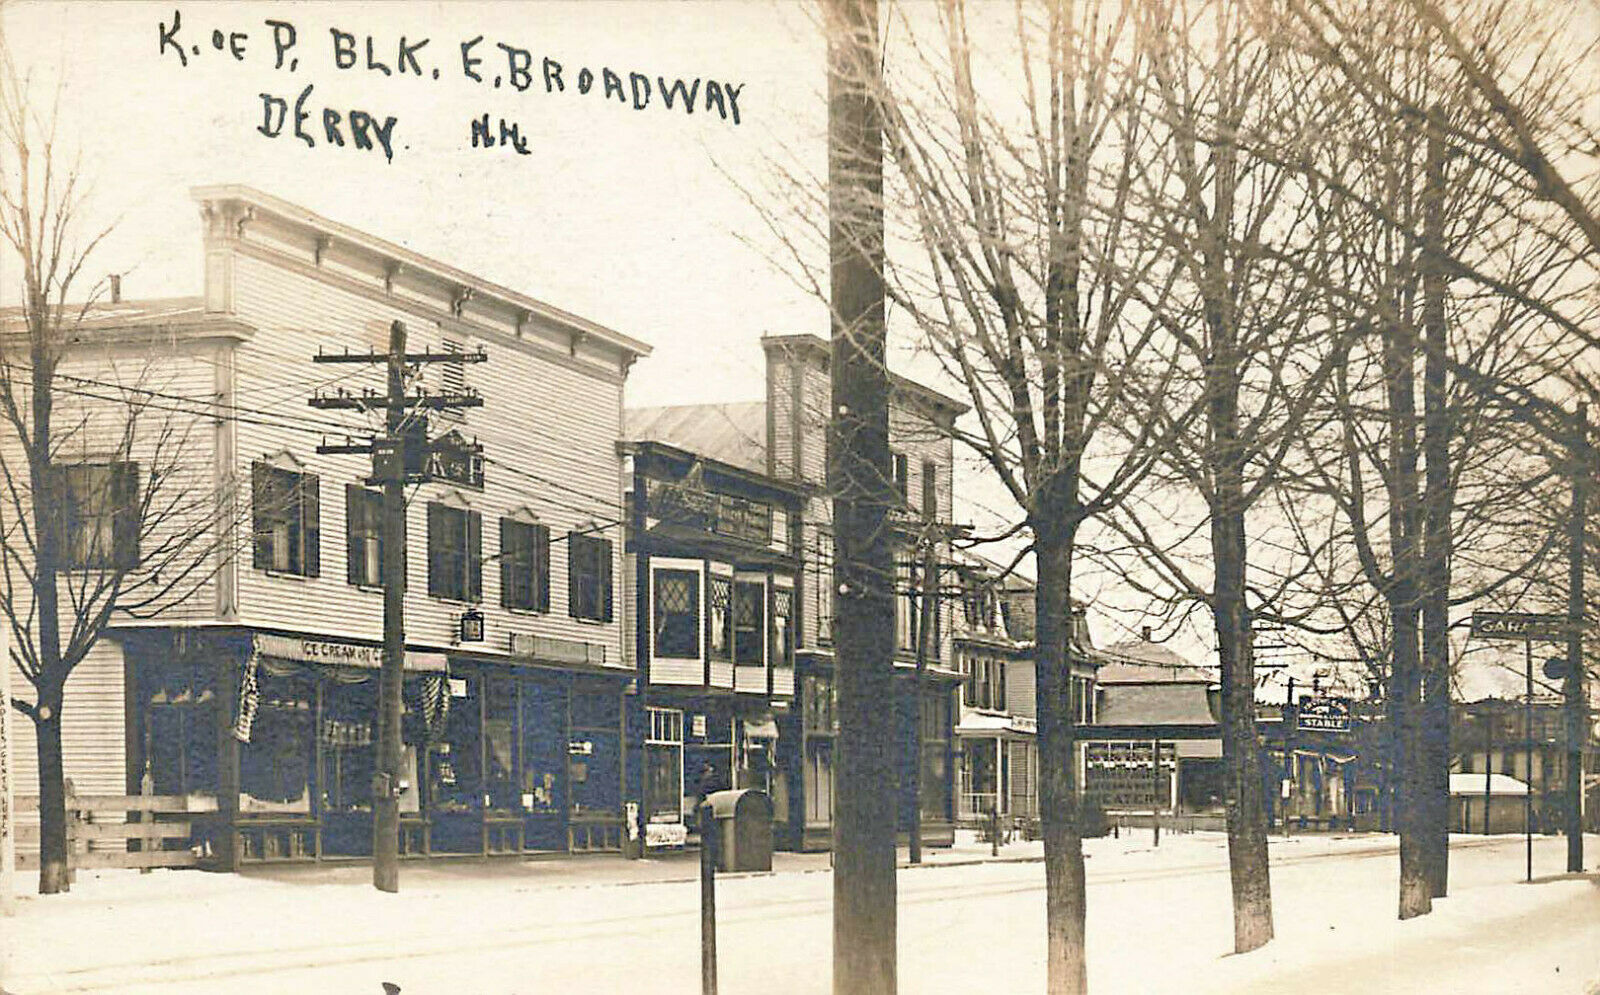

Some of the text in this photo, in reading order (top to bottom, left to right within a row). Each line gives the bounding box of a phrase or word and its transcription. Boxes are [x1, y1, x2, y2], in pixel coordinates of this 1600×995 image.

[302, 641, 319, 656] ICE
[321, 644, 357, 661] CREAM
[1304, 719, 1343, 728] STABLE
